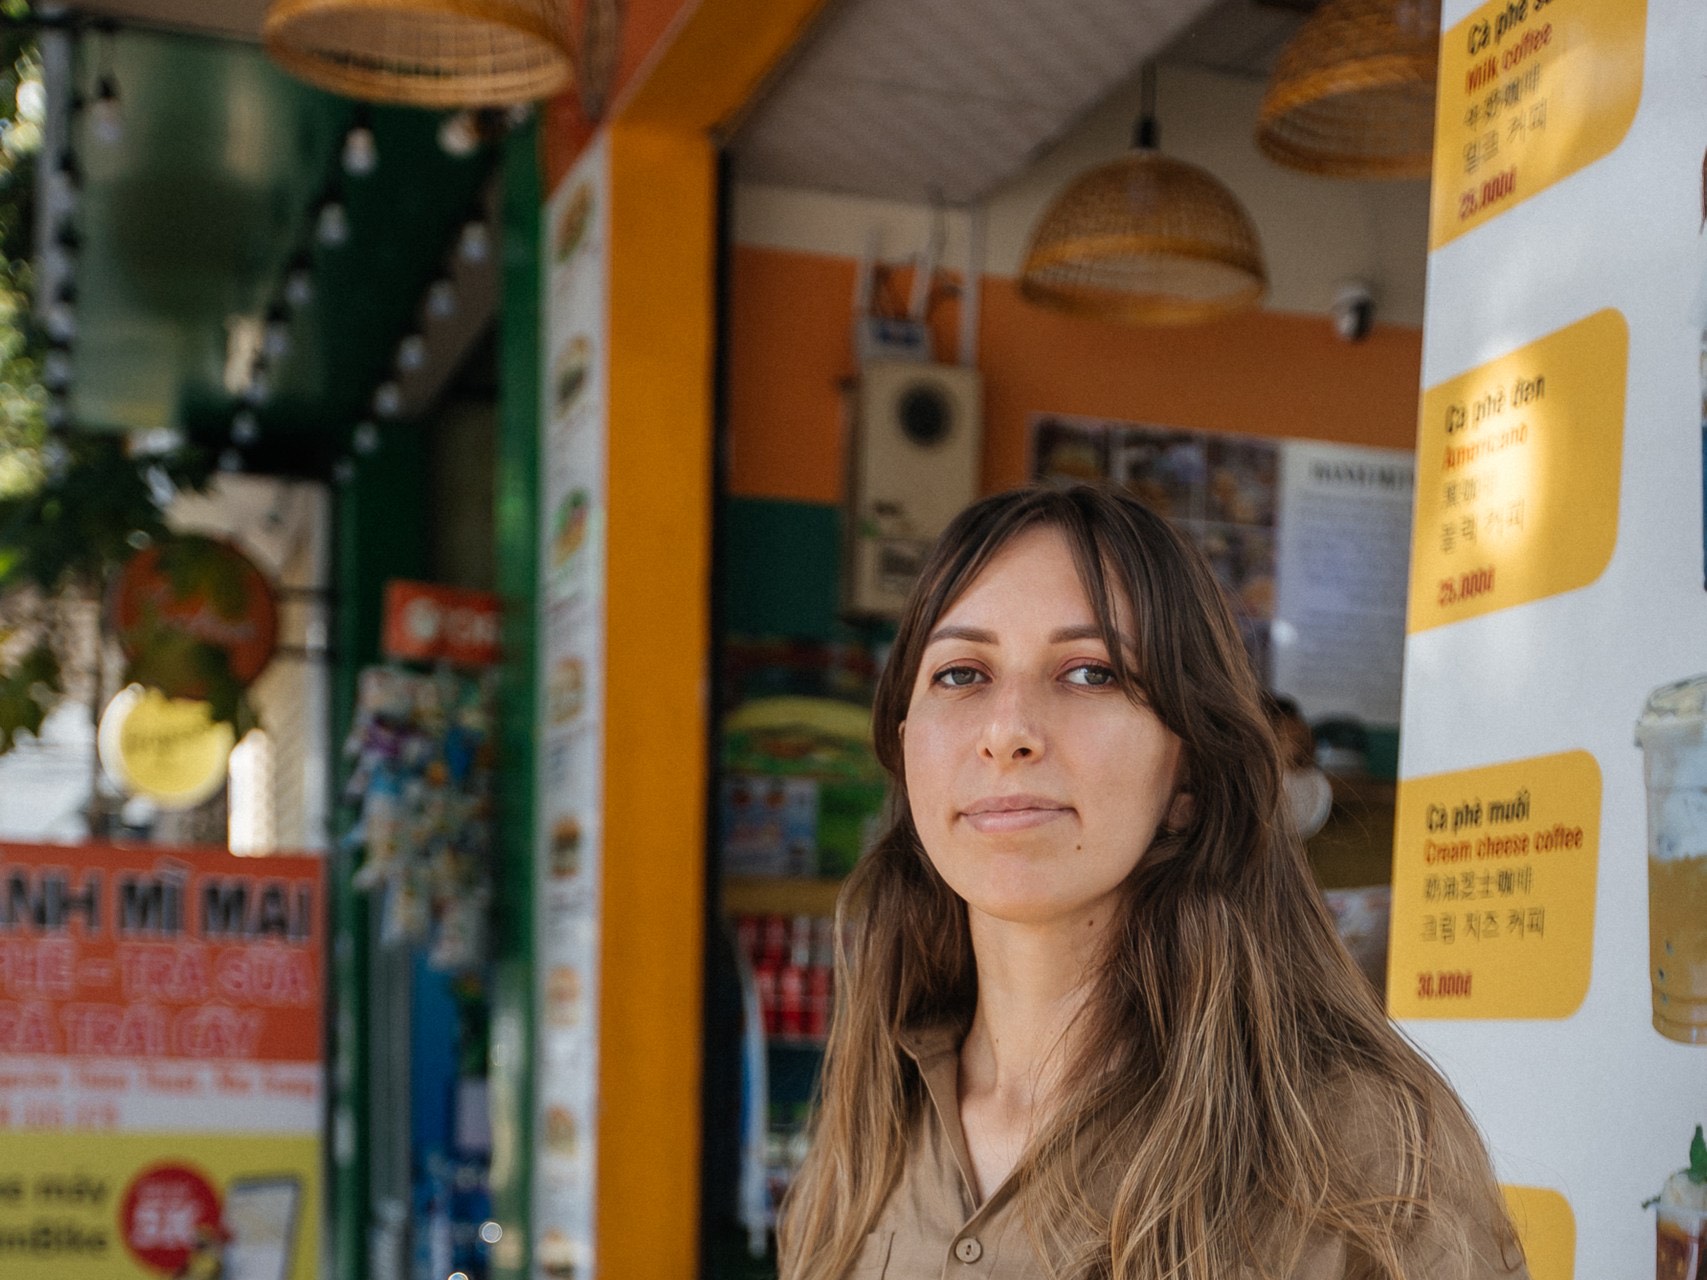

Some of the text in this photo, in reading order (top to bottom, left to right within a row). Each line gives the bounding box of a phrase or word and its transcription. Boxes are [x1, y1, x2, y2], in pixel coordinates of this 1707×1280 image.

[1465, 23, 1552, 96] Milk coffee
[1467, 18, 1491, 55] Cà
[1507, 97, 1548, 143] 커피
[1426, 786, 1531, 836] Cà phê muối
[1424, 823, 1584, 866] Cream cheese coffee
[0, 866, 103, 937] NH
[201, 877, 313, 943] MAI
[1464, 909, 1500, 942] 치즈
[1507, 905, 1545, 938] 커피
